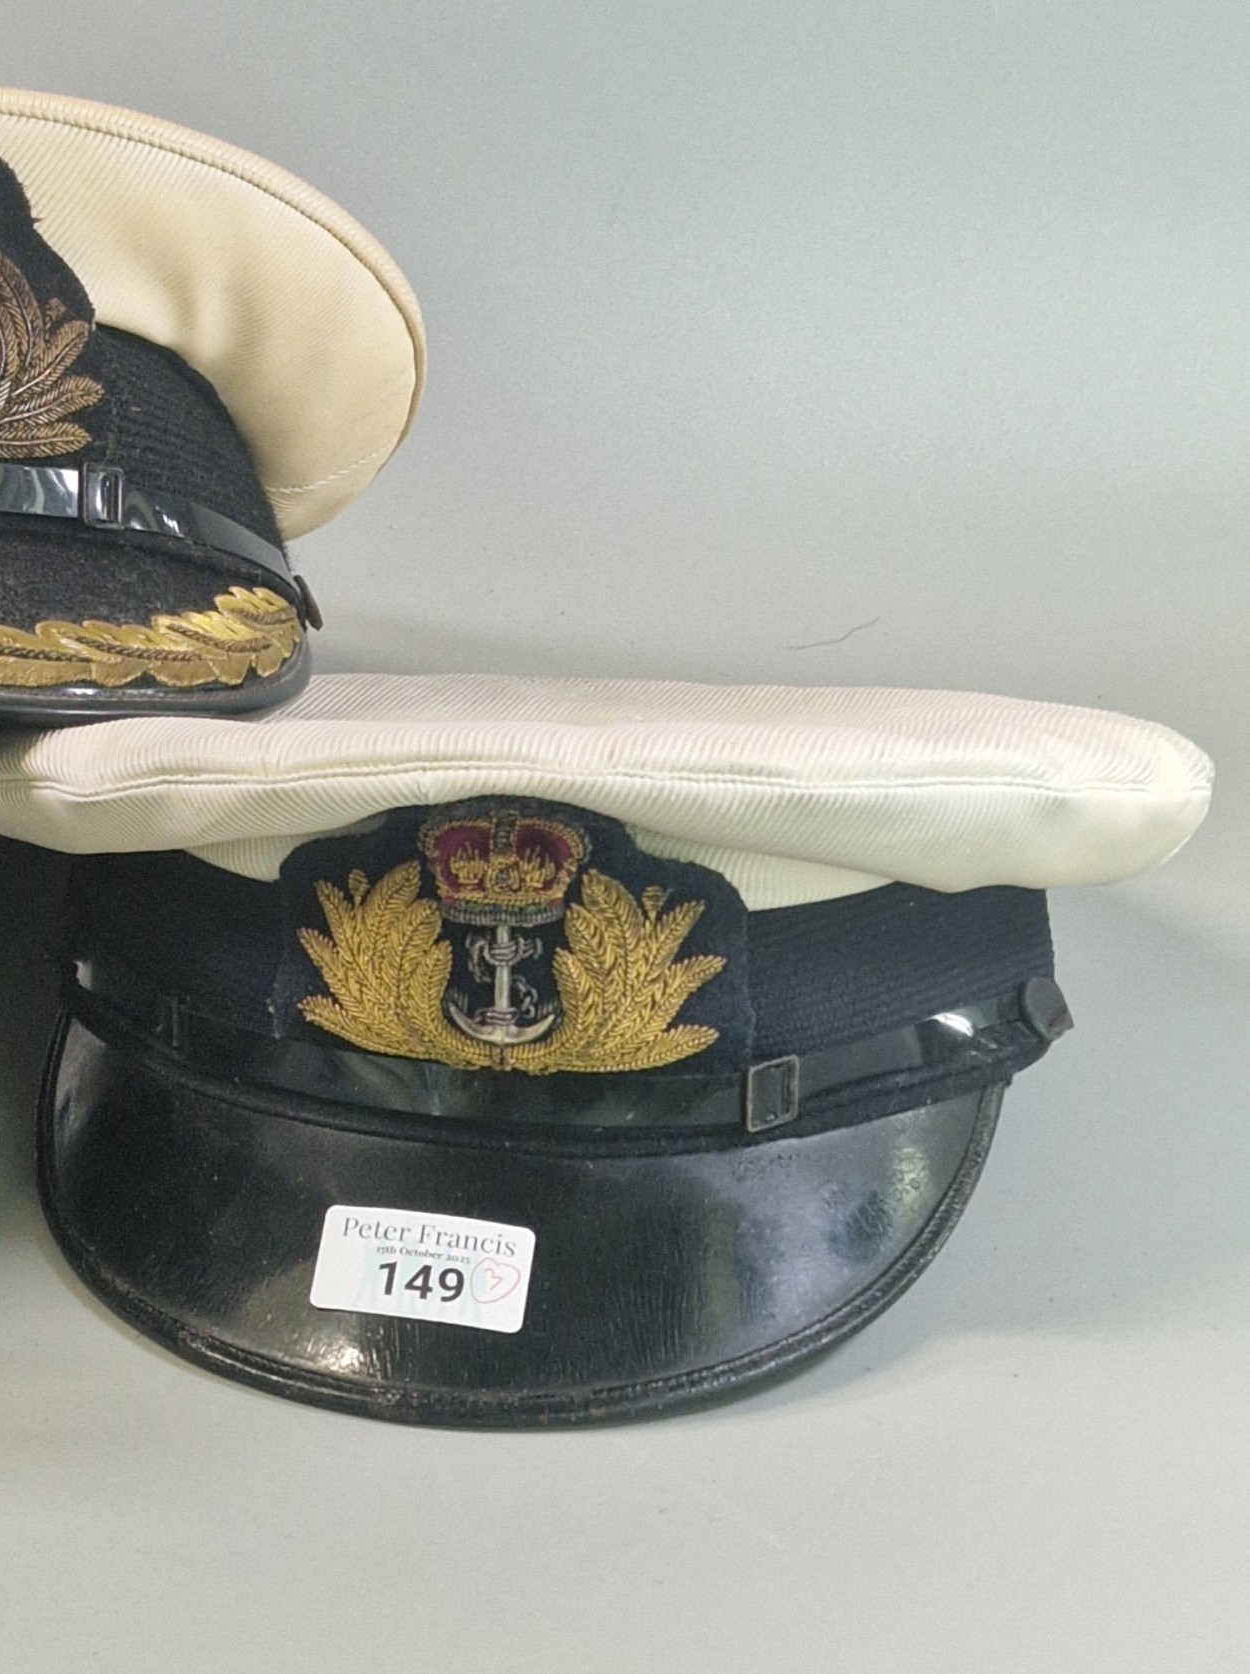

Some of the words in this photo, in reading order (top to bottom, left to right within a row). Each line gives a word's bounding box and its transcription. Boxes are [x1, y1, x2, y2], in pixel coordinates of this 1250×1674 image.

[342, 1217, 412, 1243] Peter
[418, 1223, 517, 1258] Francis
[399, 1246, 443, 1260] October
[378, 1261, 465, 1303] 149
